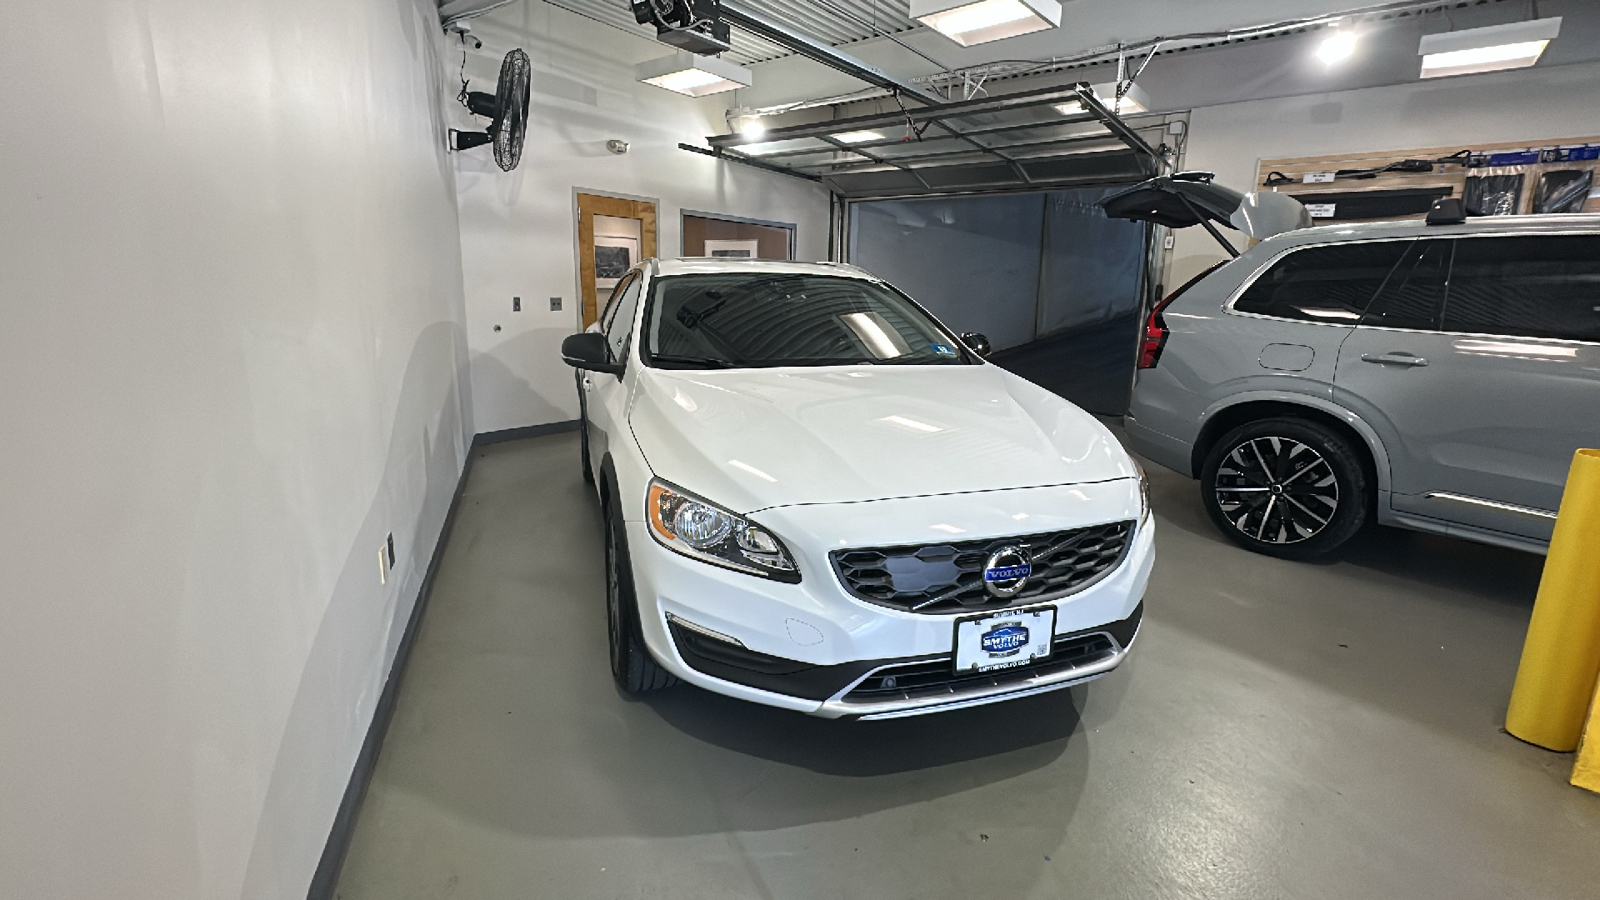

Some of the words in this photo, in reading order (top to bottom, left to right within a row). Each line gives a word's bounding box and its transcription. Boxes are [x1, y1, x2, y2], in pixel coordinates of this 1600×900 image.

[988, 567, 1029, 578] VOLVO
[983, 634, 1026, 646] SMYTHE
[993, 641, 1019, 649] VOLVO
